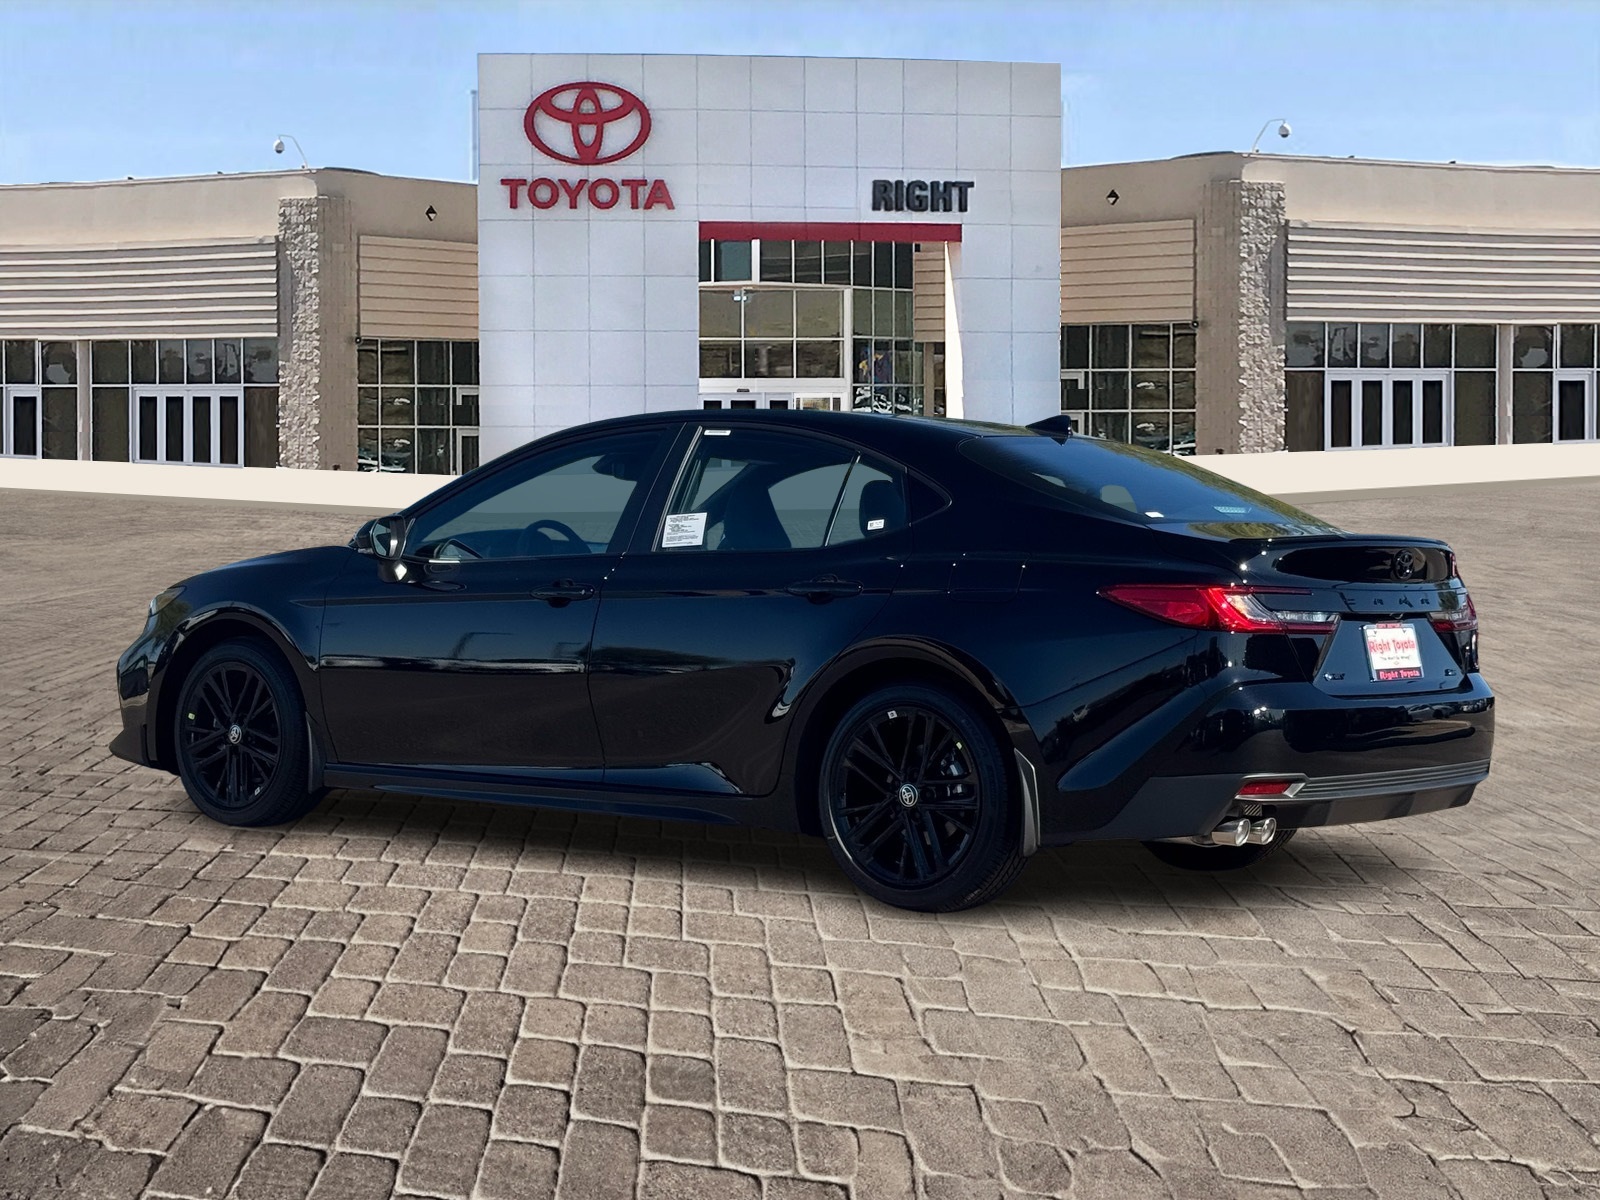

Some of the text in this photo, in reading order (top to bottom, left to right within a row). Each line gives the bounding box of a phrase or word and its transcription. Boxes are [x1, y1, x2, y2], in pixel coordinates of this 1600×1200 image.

[500, 178, 675, 210] TOYOTA
[872, 180, 975, 212] RIGHT
[1368, 638, 1415, 654] Right Toyota
[1380, 669, 1420, 680] Right Toyota
